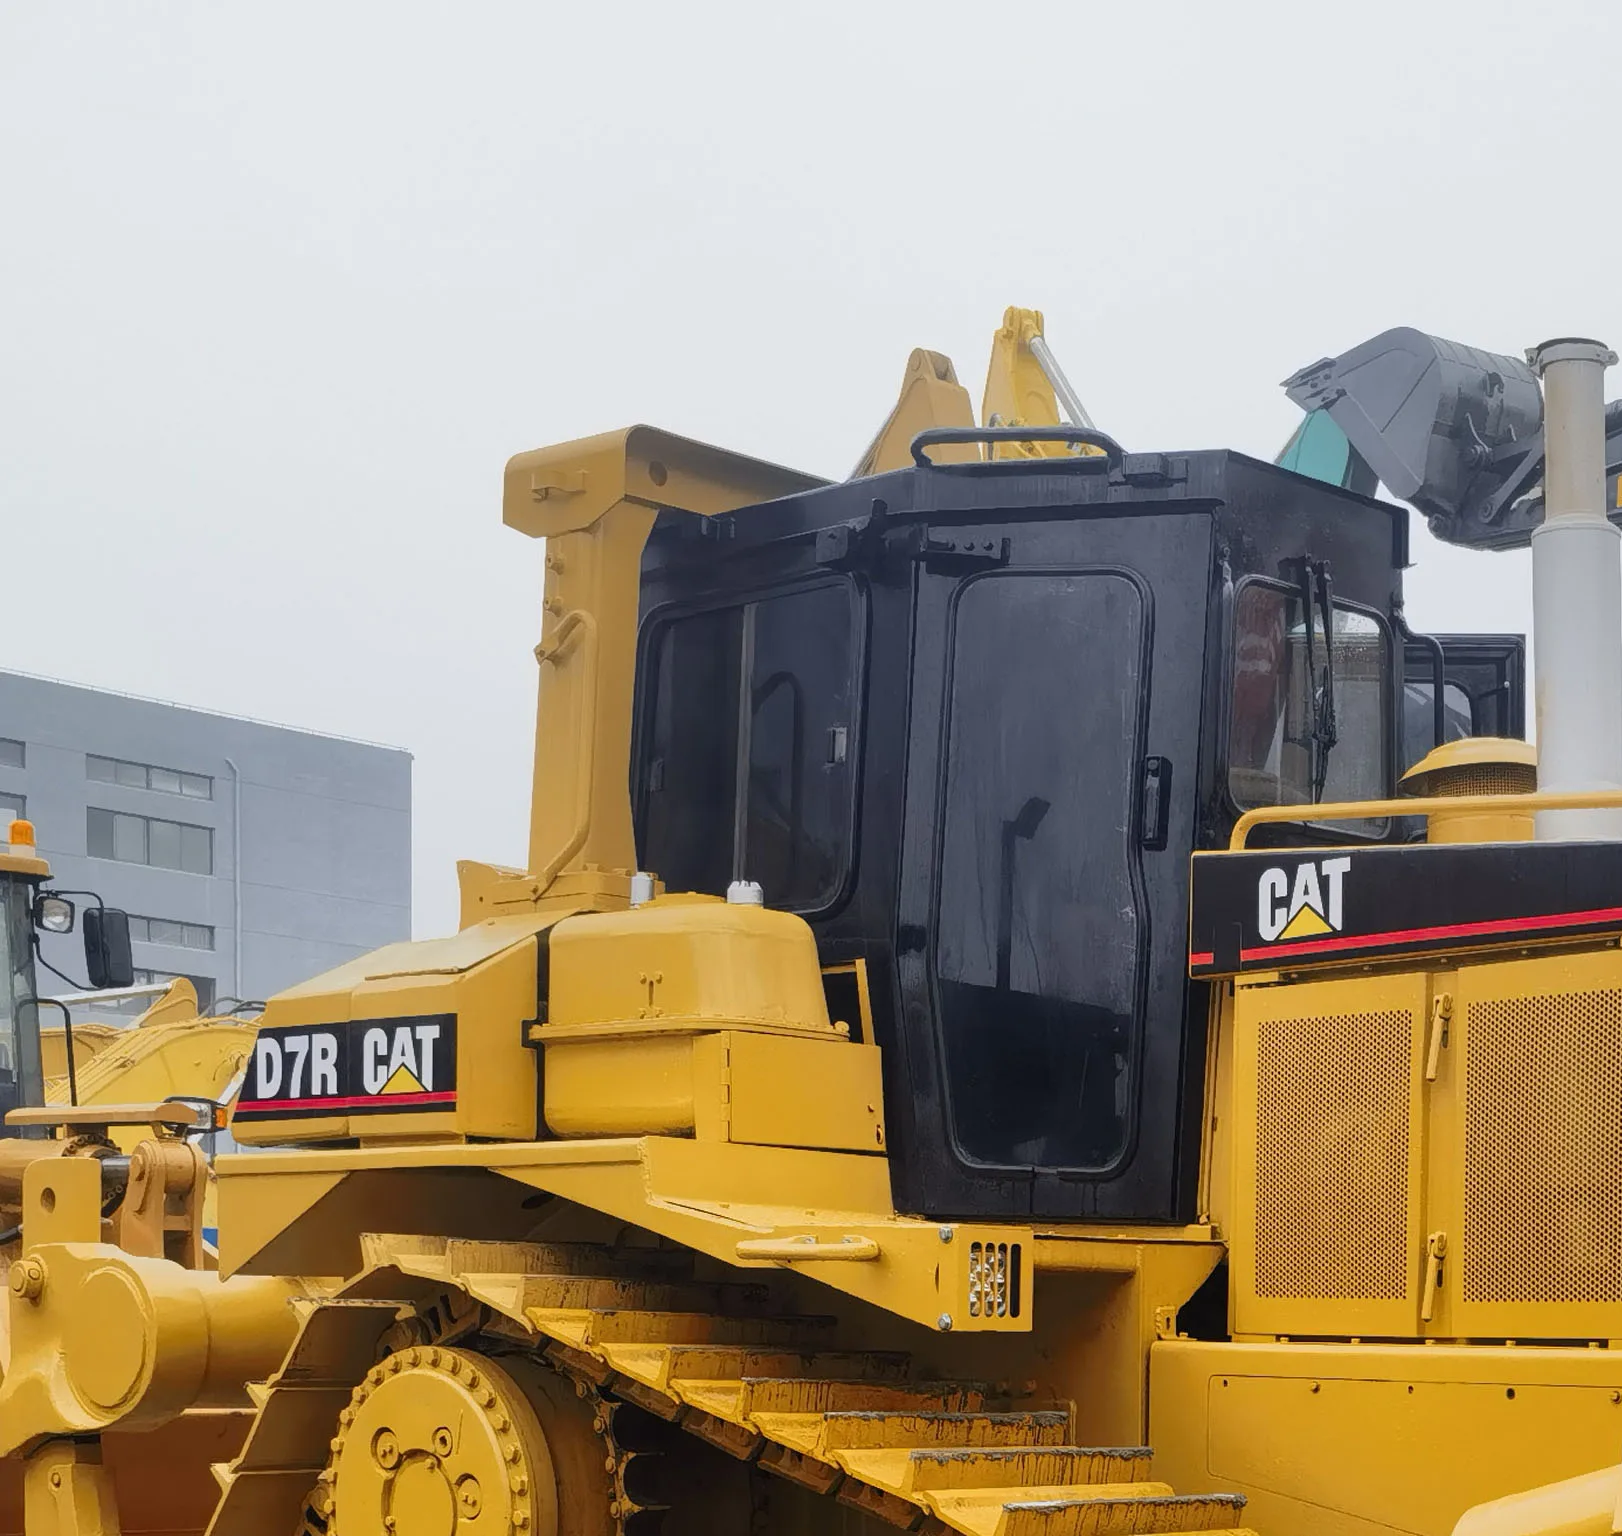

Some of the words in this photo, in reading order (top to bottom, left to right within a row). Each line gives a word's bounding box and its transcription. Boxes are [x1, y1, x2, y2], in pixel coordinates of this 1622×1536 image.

[1258, 856, 1351, 941] CAT
[256, 1033, 338, 1099] D7R
[363, 1024, 440, 1095] CAT
